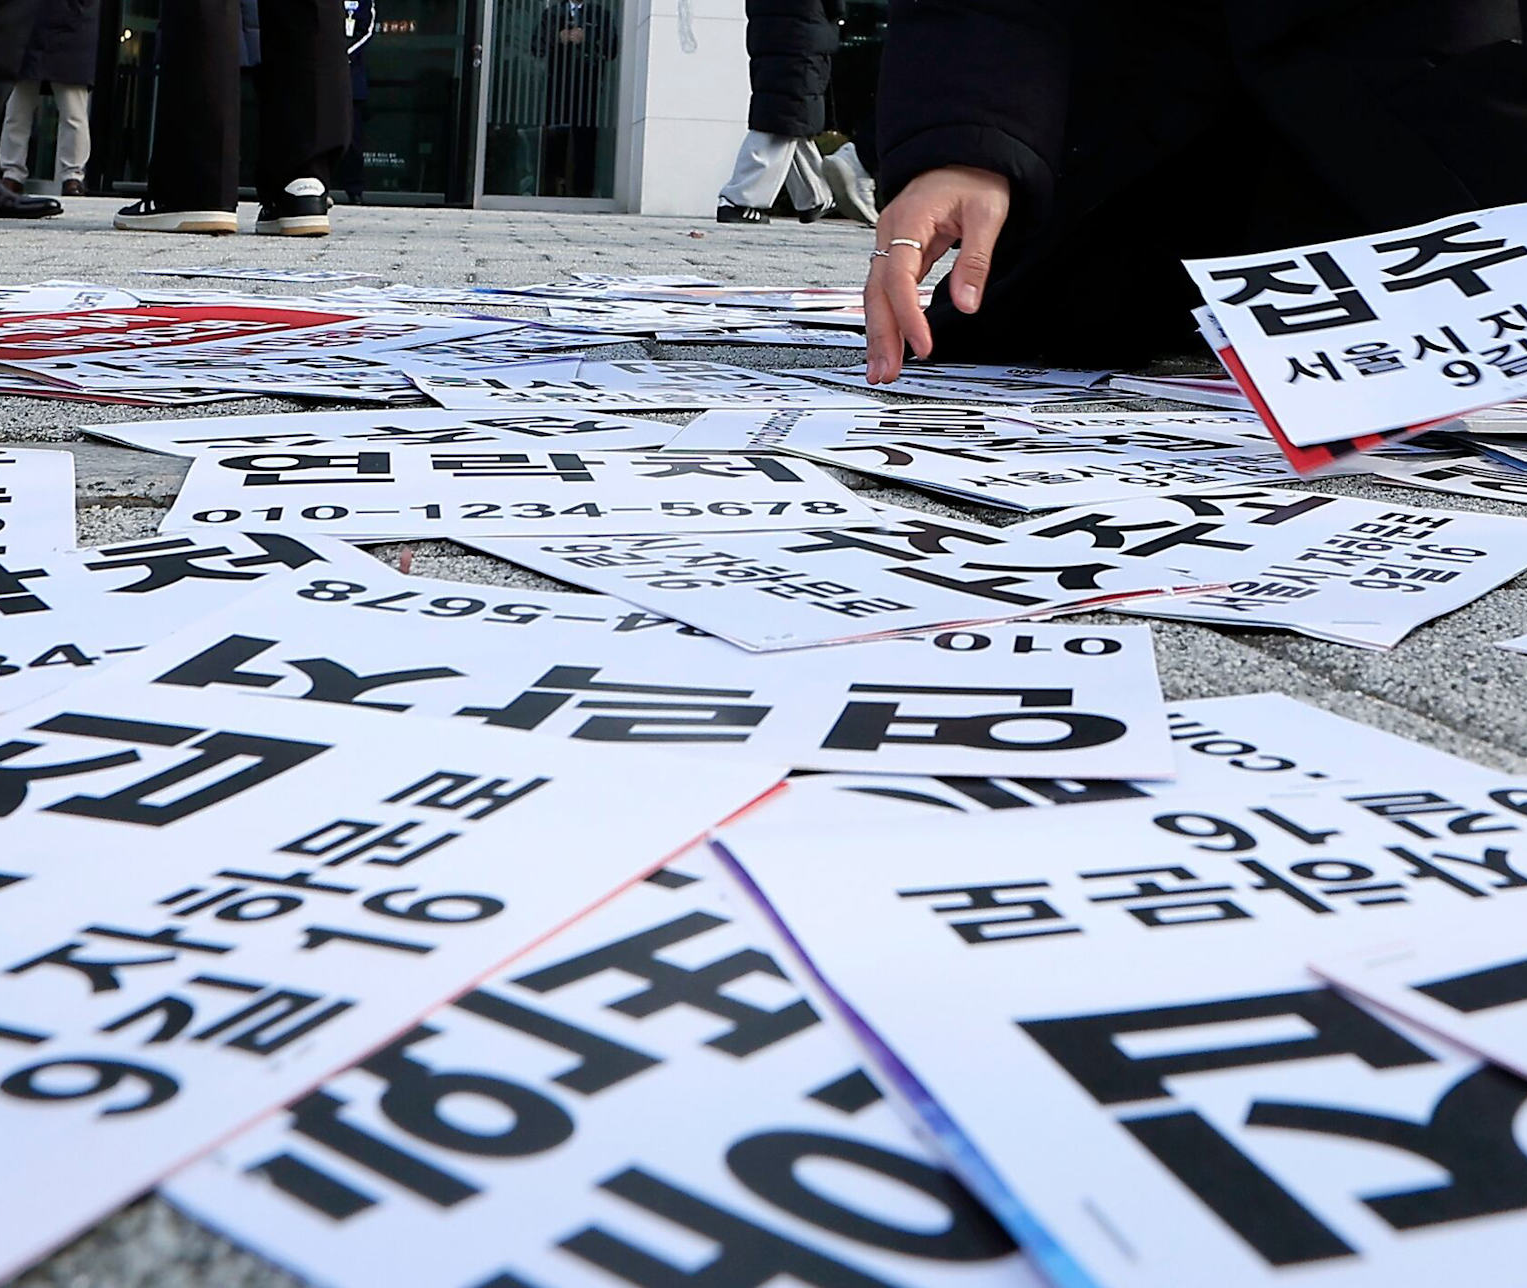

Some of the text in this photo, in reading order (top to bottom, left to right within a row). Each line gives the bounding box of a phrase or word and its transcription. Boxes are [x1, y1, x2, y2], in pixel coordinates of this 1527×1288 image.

[1285, 325, 1471, 384] 서울시
[217, 450, 805, 487] 연락처
[191, 499, 850, 524] 010-1234-5678
[1150, 804, 1346, 854] 16
[3, 768, 554, 998] 자하문로
[294, 883, 508, 958] 16
